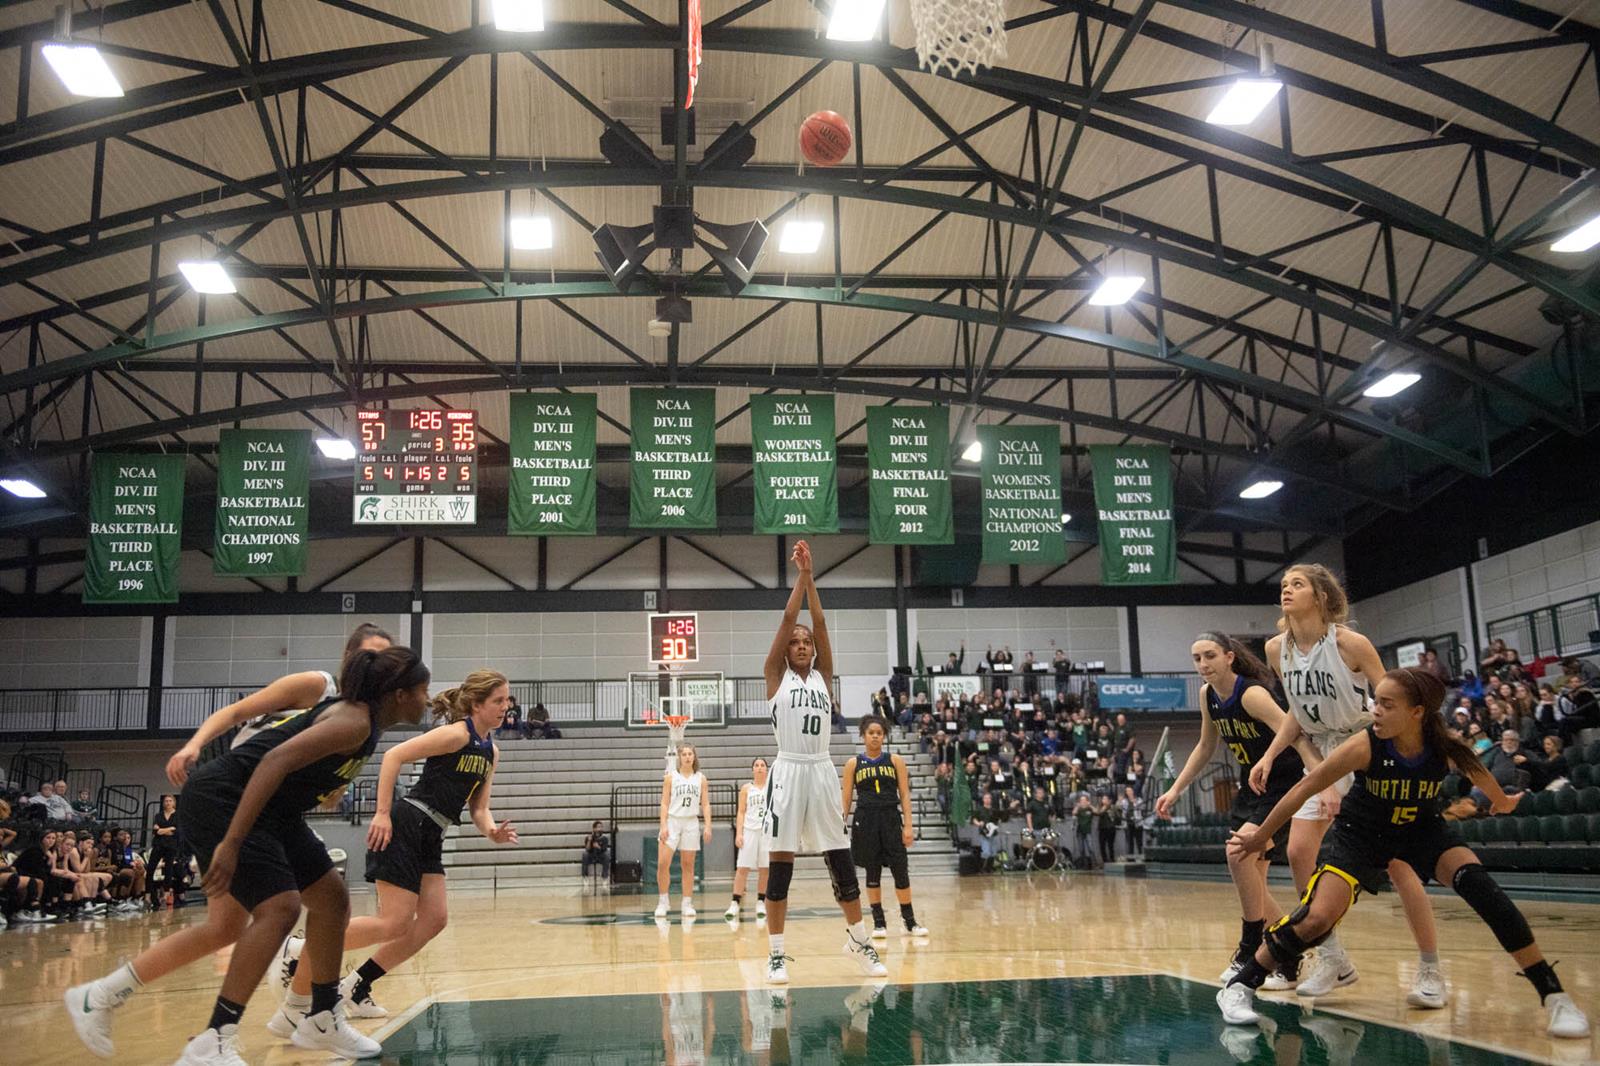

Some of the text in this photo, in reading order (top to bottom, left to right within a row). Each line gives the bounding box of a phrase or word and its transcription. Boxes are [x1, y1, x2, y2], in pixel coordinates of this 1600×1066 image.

[537, 405, 571, 416] NCAA
[656, 400, 690, 411] NCAA
[776, 403, 809, 413] NCAA
[410, 411, 442, 430] 1:26
[654, 417, 693, 428] DIV. III
[773, 415, 811, 426] DIV. III
[892, 418, 925, 429] NCAA
[362, 422, 385, 441] 57
[452, 423, 474, 441] 35
[533, 423, 573, 434] DIV. III
[408, 441, 432, 450] period
[435, 437, 444, 452] 3
[655, 435, 692, 445] MEN'S
[765, 439, 821, 450] WOMEN'S
[890, 435, 927, 446] DIV. III
[247, 442, 283, 454] NCAA
[534, 441, 571, 452] MEN'S
[1000, 441, 1039, 452] NCAA
[404, 455, 428, 463] player
[455, 455, 472, 463] fouls
[635, 451, 712, 463] BASKETBALL
[756, 451, 832, 463] BASKETBALL
[891, 453, 927, 463] MEN'S
[998, 454, 1042, 465] DIV. III
[243, 460, 286, 471] DIV. III
[513, 457, 592, 469] BASKETBALL
[1116, 458, 1148, 469] NCAA
[119, 467, 156, 479] NCAA
[364, 466, 373, 480] 5
[384, 467, 393, 479] 4
[438, 466, 448, 480] 2
[461, 466, 470, 480] 5
[653, 469, 691, 480] THIRD
[872, 469, 948, 481] BASKETBALL
[244, 478, 283, 490] MEN'S
[531, 476, 570, 487] THIRD
[770, 477, 819, 487] FOURTH
[992, 474, 1050, 486] WOMEN'S
[1114, 476, 1152, 486] DIV. III
[115, 486, 157, 497] DIV. III
[406, 485, 424, 493] game
[654, 487, 693, 499] PLACE
[775, 489, 814, 500] PLACE
[893, 487, 928, 498] FINAL
[985, 488, 1060, 500] BASKETBALL
[221, 497, 305, 508] BASKETBALL
[391, 497, 438, 508] SHIRK
[531, 494, 572, 505] PLACE
[1117, 493, 1152, 503] MEN'S
[115, 504, 155, 516] MEN'S
[384, 510, 445, 520] CENTER
[661, 505, 685, 516] 2006
[895, 505, 927, 516] FOUR
[989, 508, 1057, 519] NATIONAL
[1099, 510, 1171, 520] BASKETBALL
[228, 515, 294, 526] NATIONAL
[539, 512, 563, 523] 2001
[784, 514, 806, 525] 2011
[90, 523, 177, 534] BASKETBALL
[900, 522, 923, 533] 2012
[986, 522, 1062, 533] CHAMPIONS
[1120, 528, 1154, 538] FINAL
[222, 533, 300, 545] CHAMPIONS
[110, 541, 152, 553] THIRD
[1010, 540, 1039, 551] 2012
[1122, 545, 1154, 556] FOUR
[248, 552, 273, 564] 1997
[109, 560, 153, 572] PLACE
[1128, 563, 1151, 574] 2014
[118, 579, 143, 590] 1996
[343, 597, 353, 608] G
[645, 594, 655, 606] H
[668, 620, 694, 635] 1:26
[662, 638, 687, 660] 30
[1101, 684, 1145, 695] CEFCU
[1284, 670, 1337, 700] ITANS
[790, 688, 829, 714] TITANS
[802, 714, 821, 735] 10
[456, 755, 485, 774] NORTH
[879, 765, 896, 779] PARK
[875, 780, 880, 794] 1
[1365, 776, 1411, 800] NORTH
[682, 796, 691, 807] 13
[749, 794, 765, 807] TITA
[1391, 806, 1418, 825] 15
